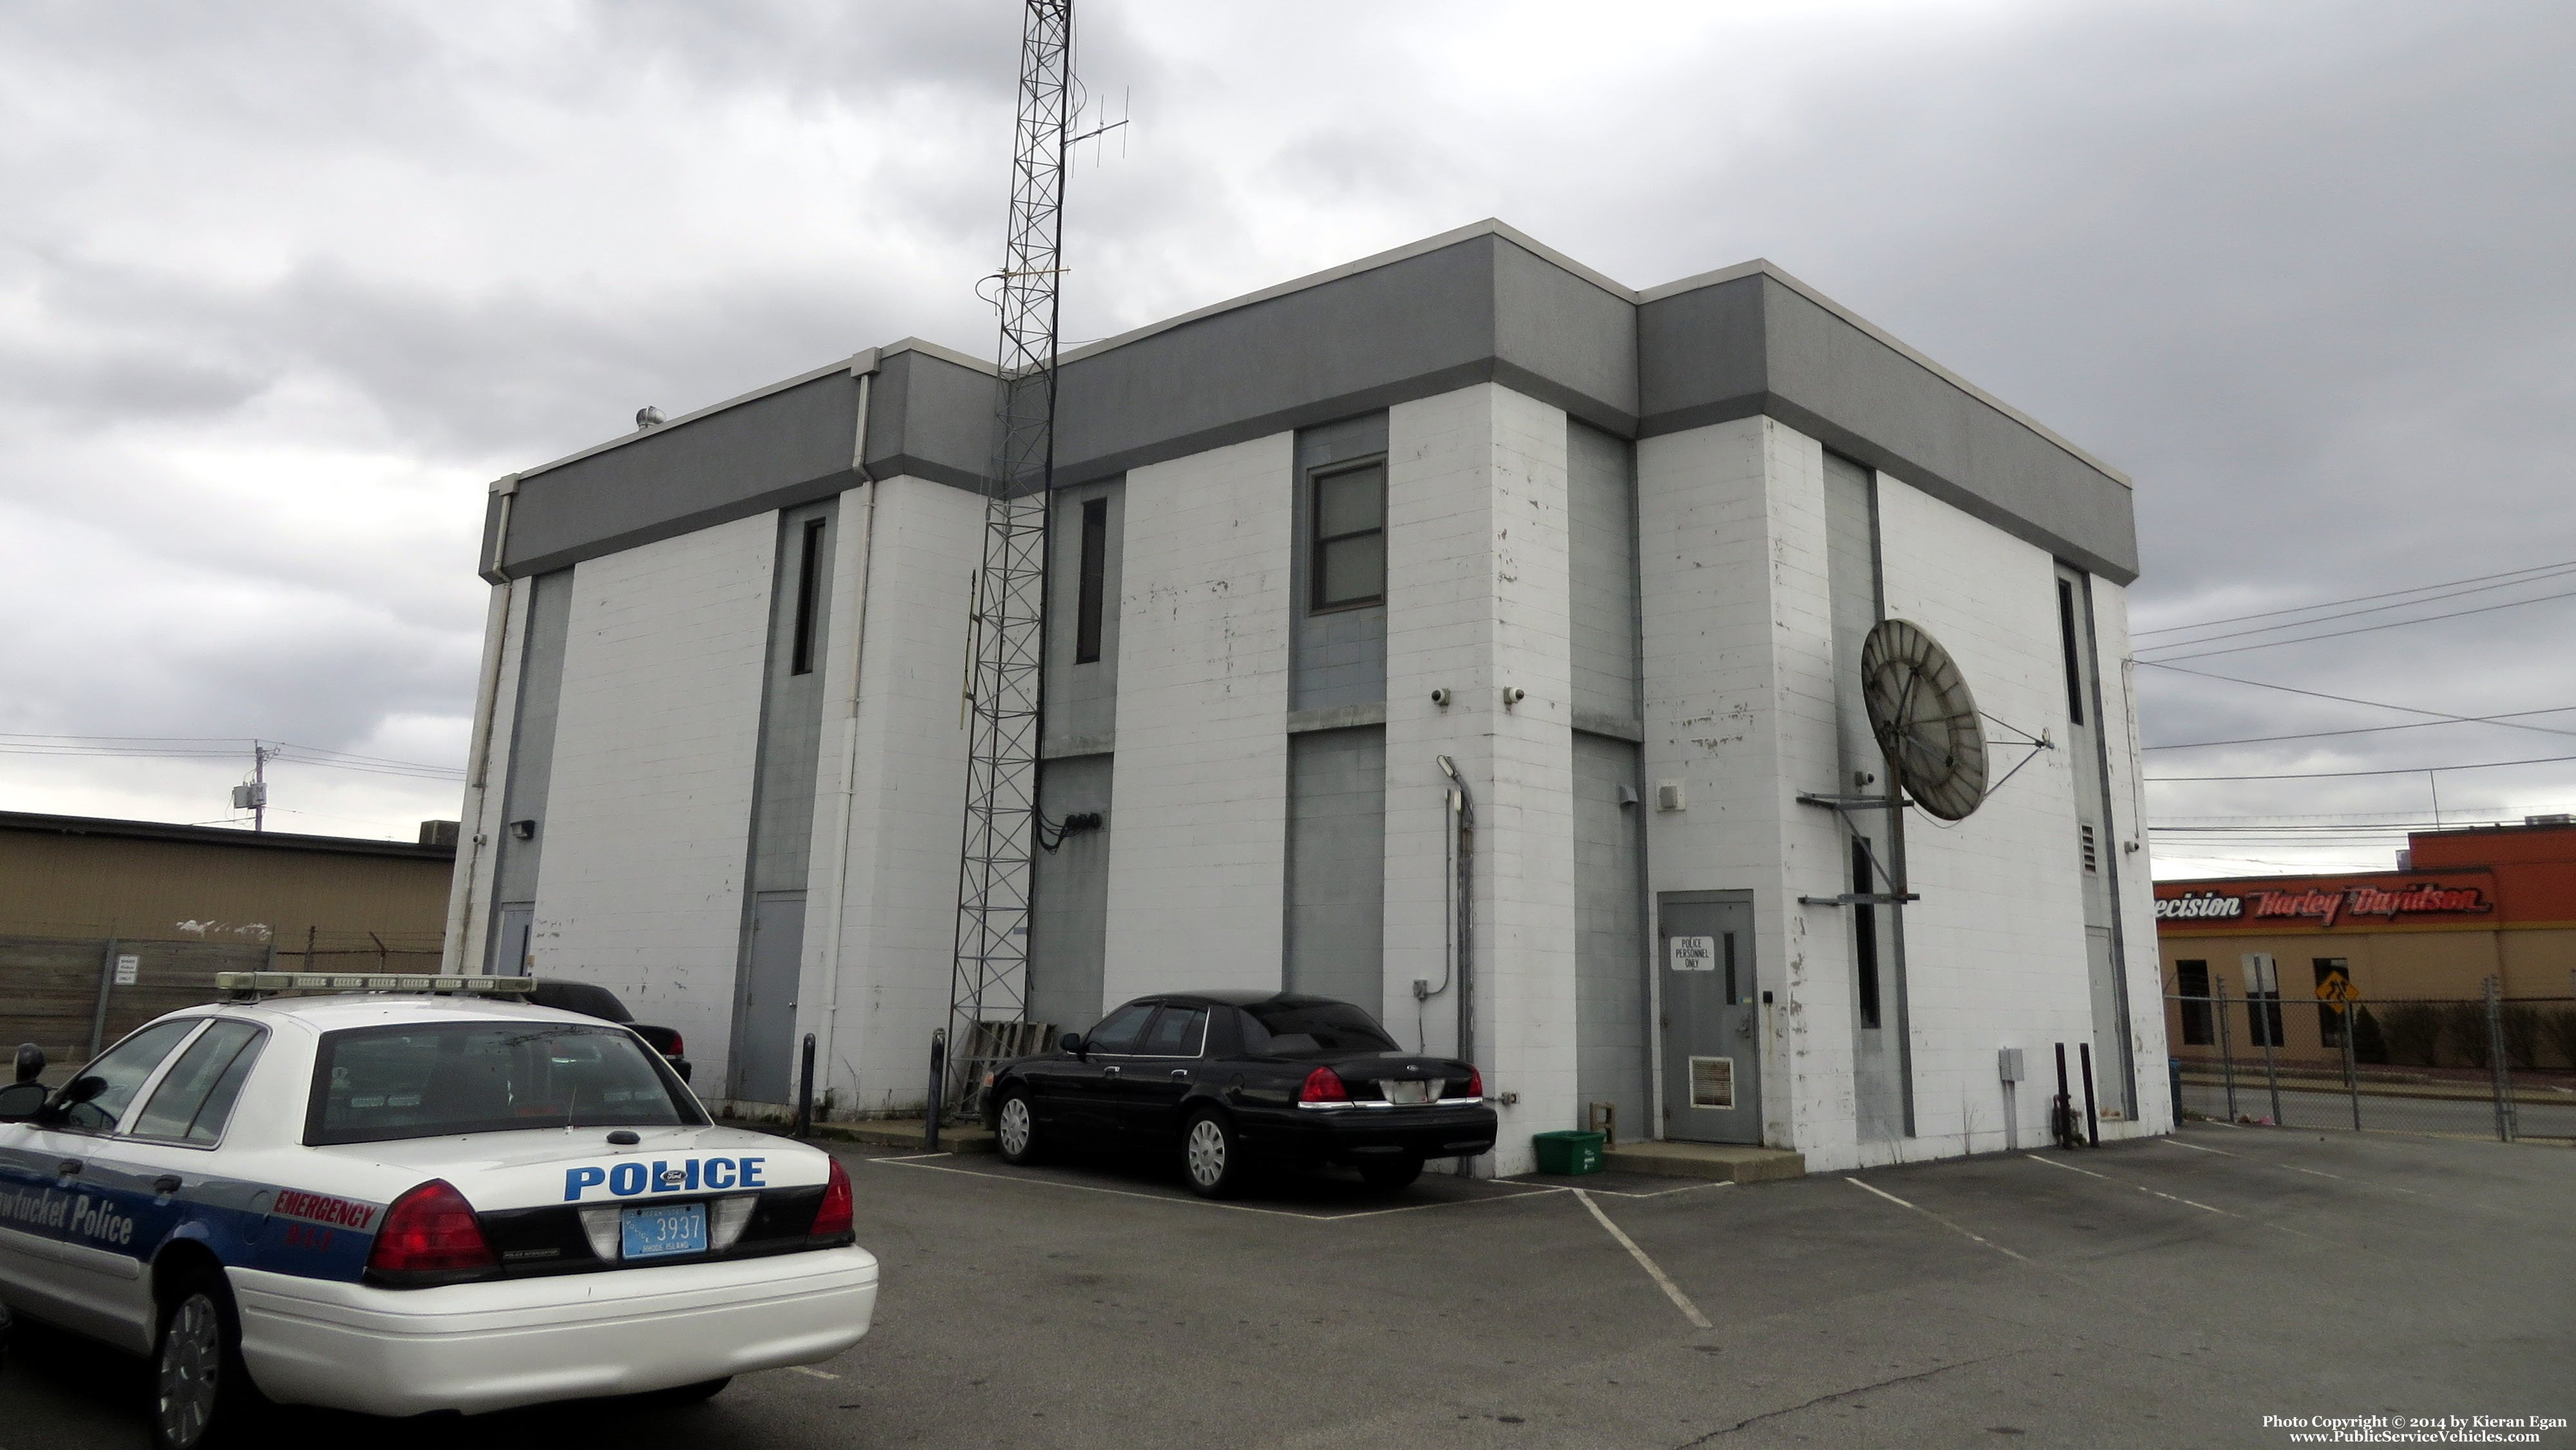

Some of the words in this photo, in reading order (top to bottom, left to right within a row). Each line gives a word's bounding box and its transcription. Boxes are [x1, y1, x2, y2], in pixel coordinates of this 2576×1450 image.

[2245, 890, 2344, 926] Harley
[1676, 949, 1709, 959] PERSONNEL
[1681, 939, 1701, 948] POLICE
[1685, 959, 1699, 968] ONLY
[564, 1158, 766, 1201] POLICE
[70, 1194, 133, 1245] Police
[272, 1190, 377, 1229] EMERGENCY
[627, 1220, 649, 1243] POLICE
[657, 1215, 700, 1241] 3937
